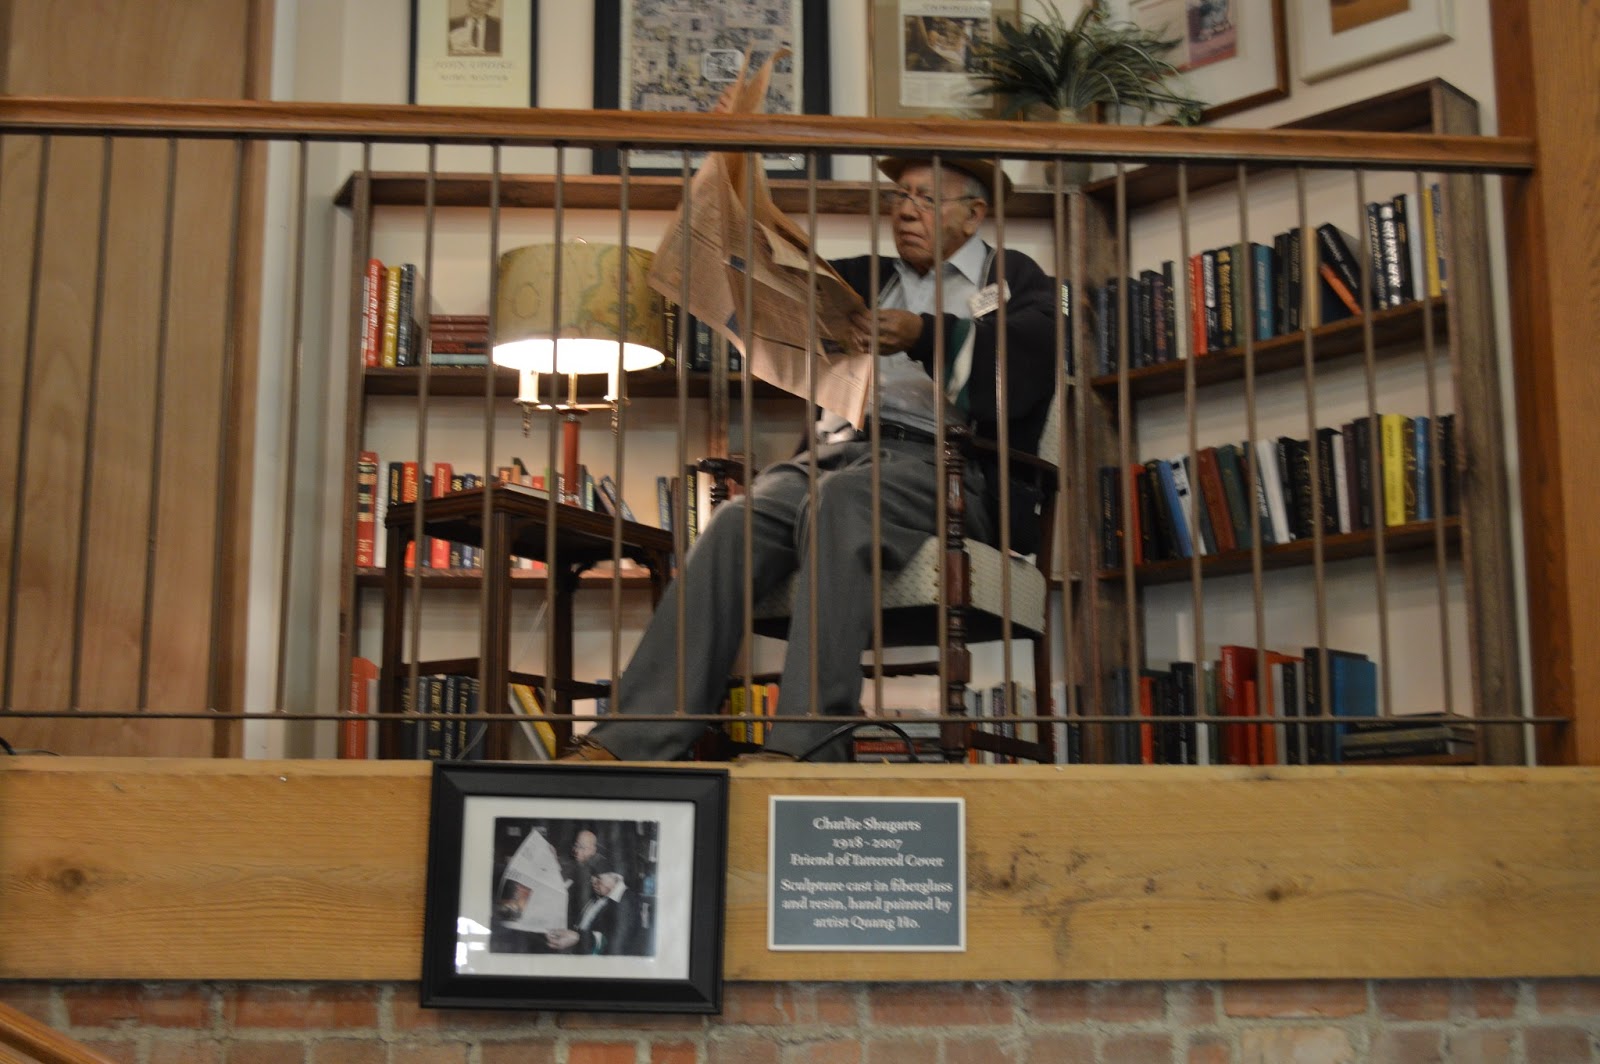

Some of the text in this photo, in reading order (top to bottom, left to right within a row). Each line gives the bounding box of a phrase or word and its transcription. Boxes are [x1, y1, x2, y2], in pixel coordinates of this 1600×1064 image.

[813, 816, 921, 833] Charlie Shugarts
[832, 836, 863, 850] 1918
[872, 838, 902, 850] 2007
[790, 852, 944, 867] Friend of Tattered Cover
[780, 877, 953, 894] Sculpture cast in fiberglass
[782, 896, 952, 914] and resin, hand painted by
[813, 915, 920, 931] artist Quang Ho.
